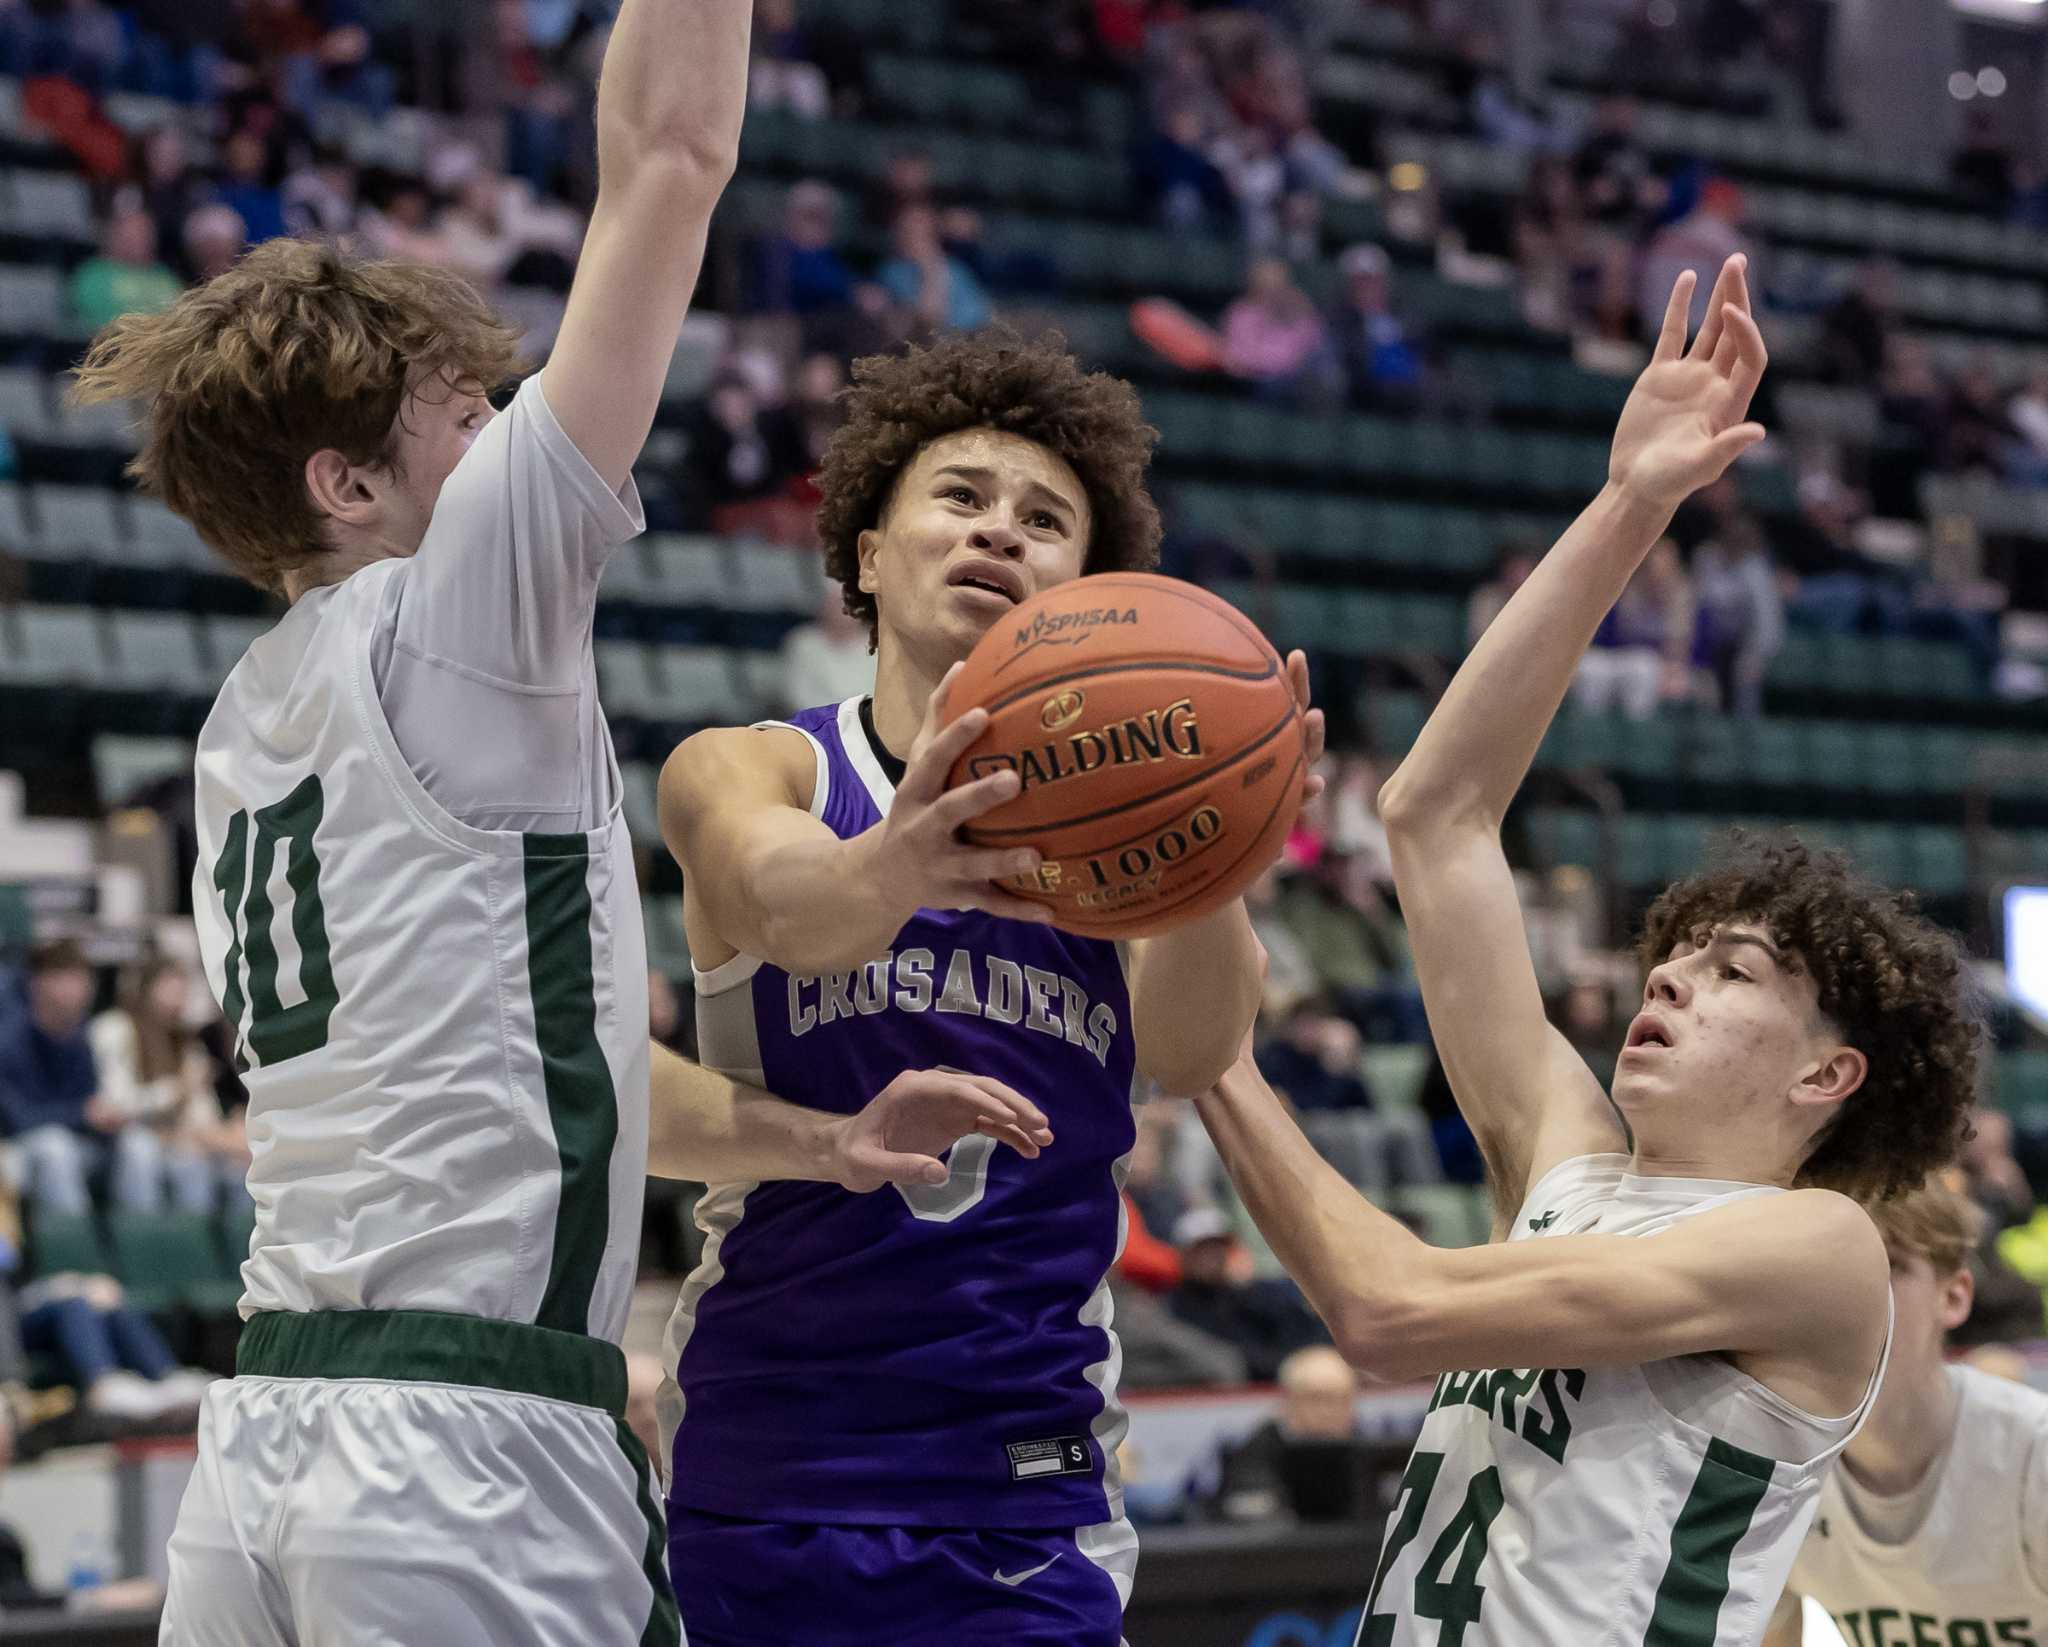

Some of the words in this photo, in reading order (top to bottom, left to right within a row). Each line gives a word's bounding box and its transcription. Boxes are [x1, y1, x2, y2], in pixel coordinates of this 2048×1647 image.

[1014, 607, 1138, 647] NYSPHSAA
[969, 698, 1204, 793] ALDING
[213, 773, 340, 1072] 10
[787, 947, 1117, 1068] CRUSADERS
[1071, 1445, 1083, 1462] S
[1354, 1451, 1505, 1647] 24
